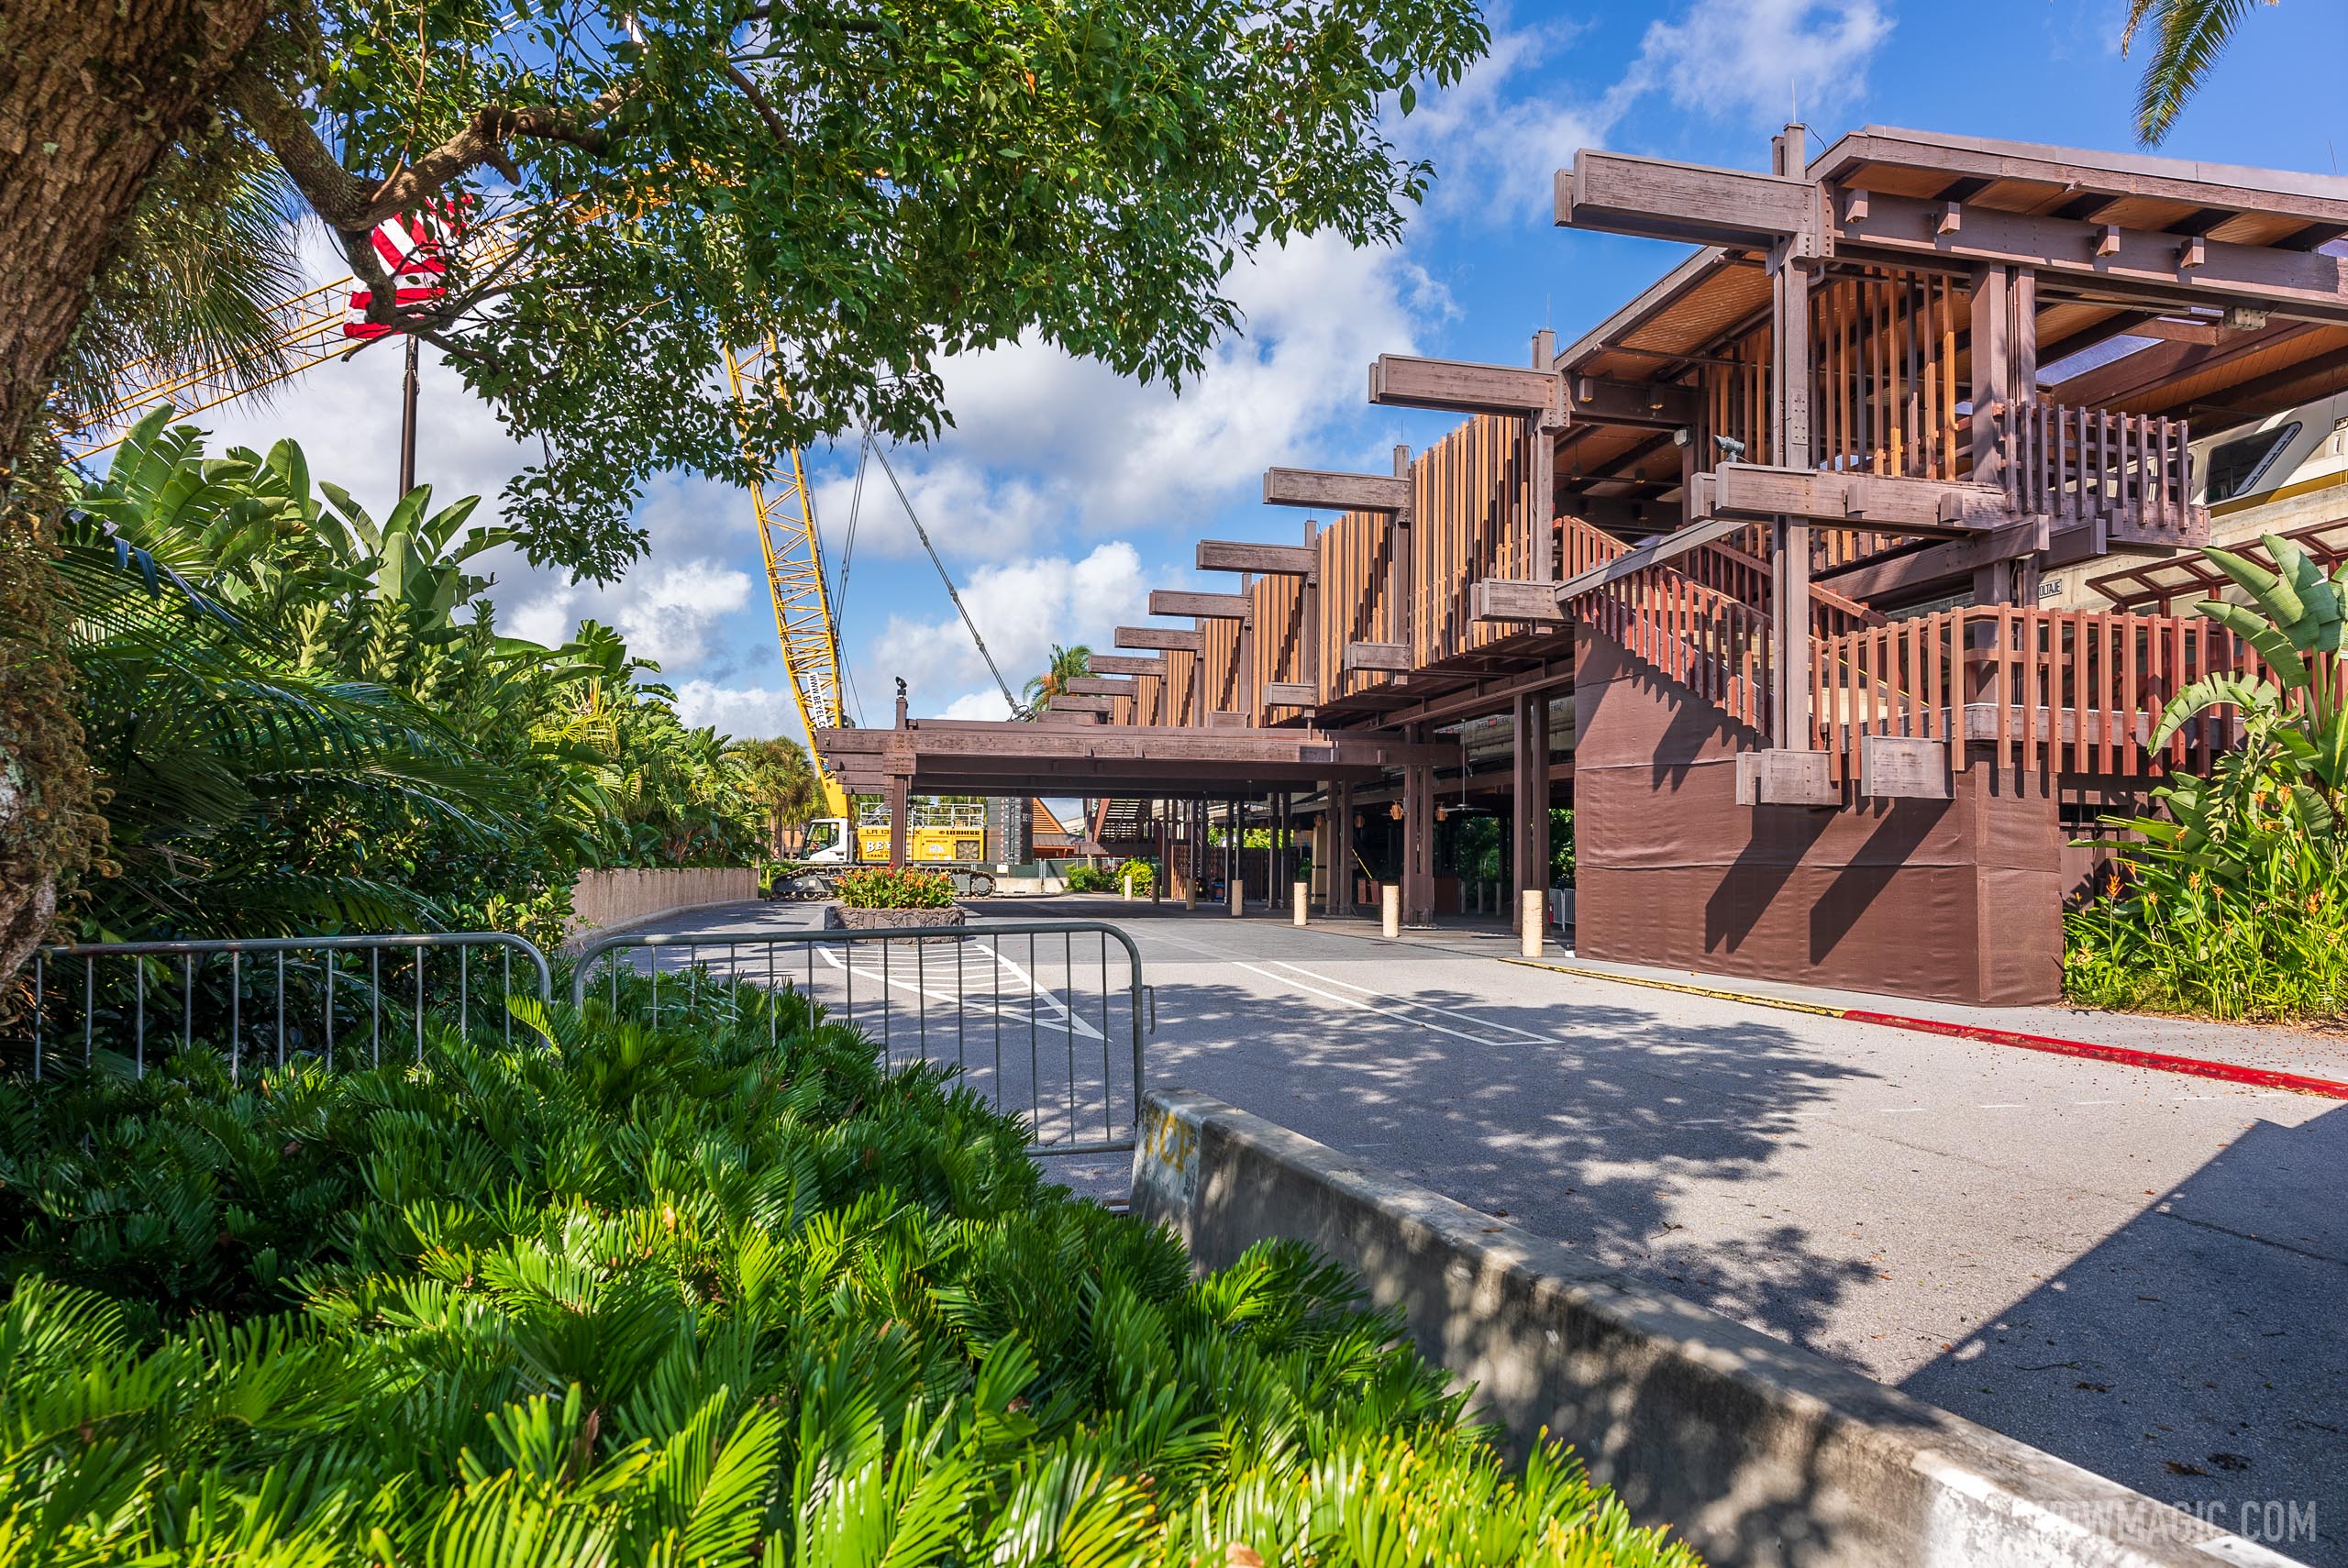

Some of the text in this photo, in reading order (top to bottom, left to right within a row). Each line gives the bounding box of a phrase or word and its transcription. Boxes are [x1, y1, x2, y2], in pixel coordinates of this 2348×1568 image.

[2039, 580, 2061, 597] OLTAJE
[809, 674, 826, 728] WWW.BEYEL.C
[866, 841, 892, 853] BEY
